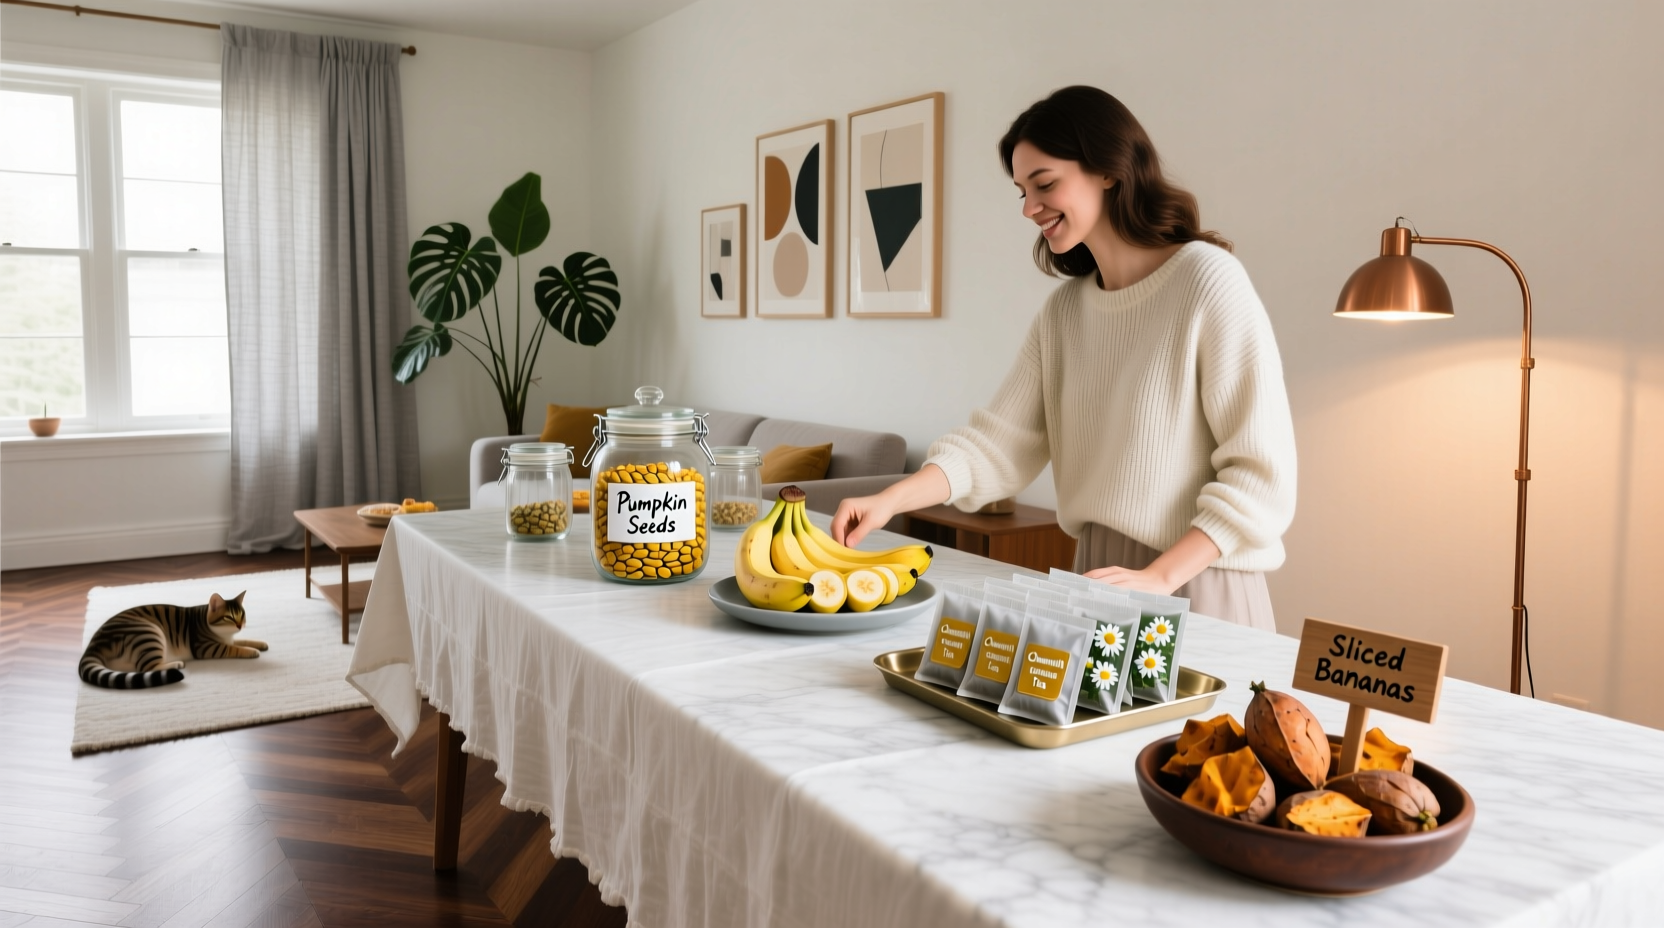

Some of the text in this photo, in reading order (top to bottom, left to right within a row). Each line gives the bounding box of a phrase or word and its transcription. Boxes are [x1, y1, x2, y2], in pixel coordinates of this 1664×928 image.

[617, 490, 687, 519] Pumpkin
[627, 514, 676, 534] Seeds
[1328, 634, 1406, 671] Sliced
[1314, 657, 1416, 703] Bananas
